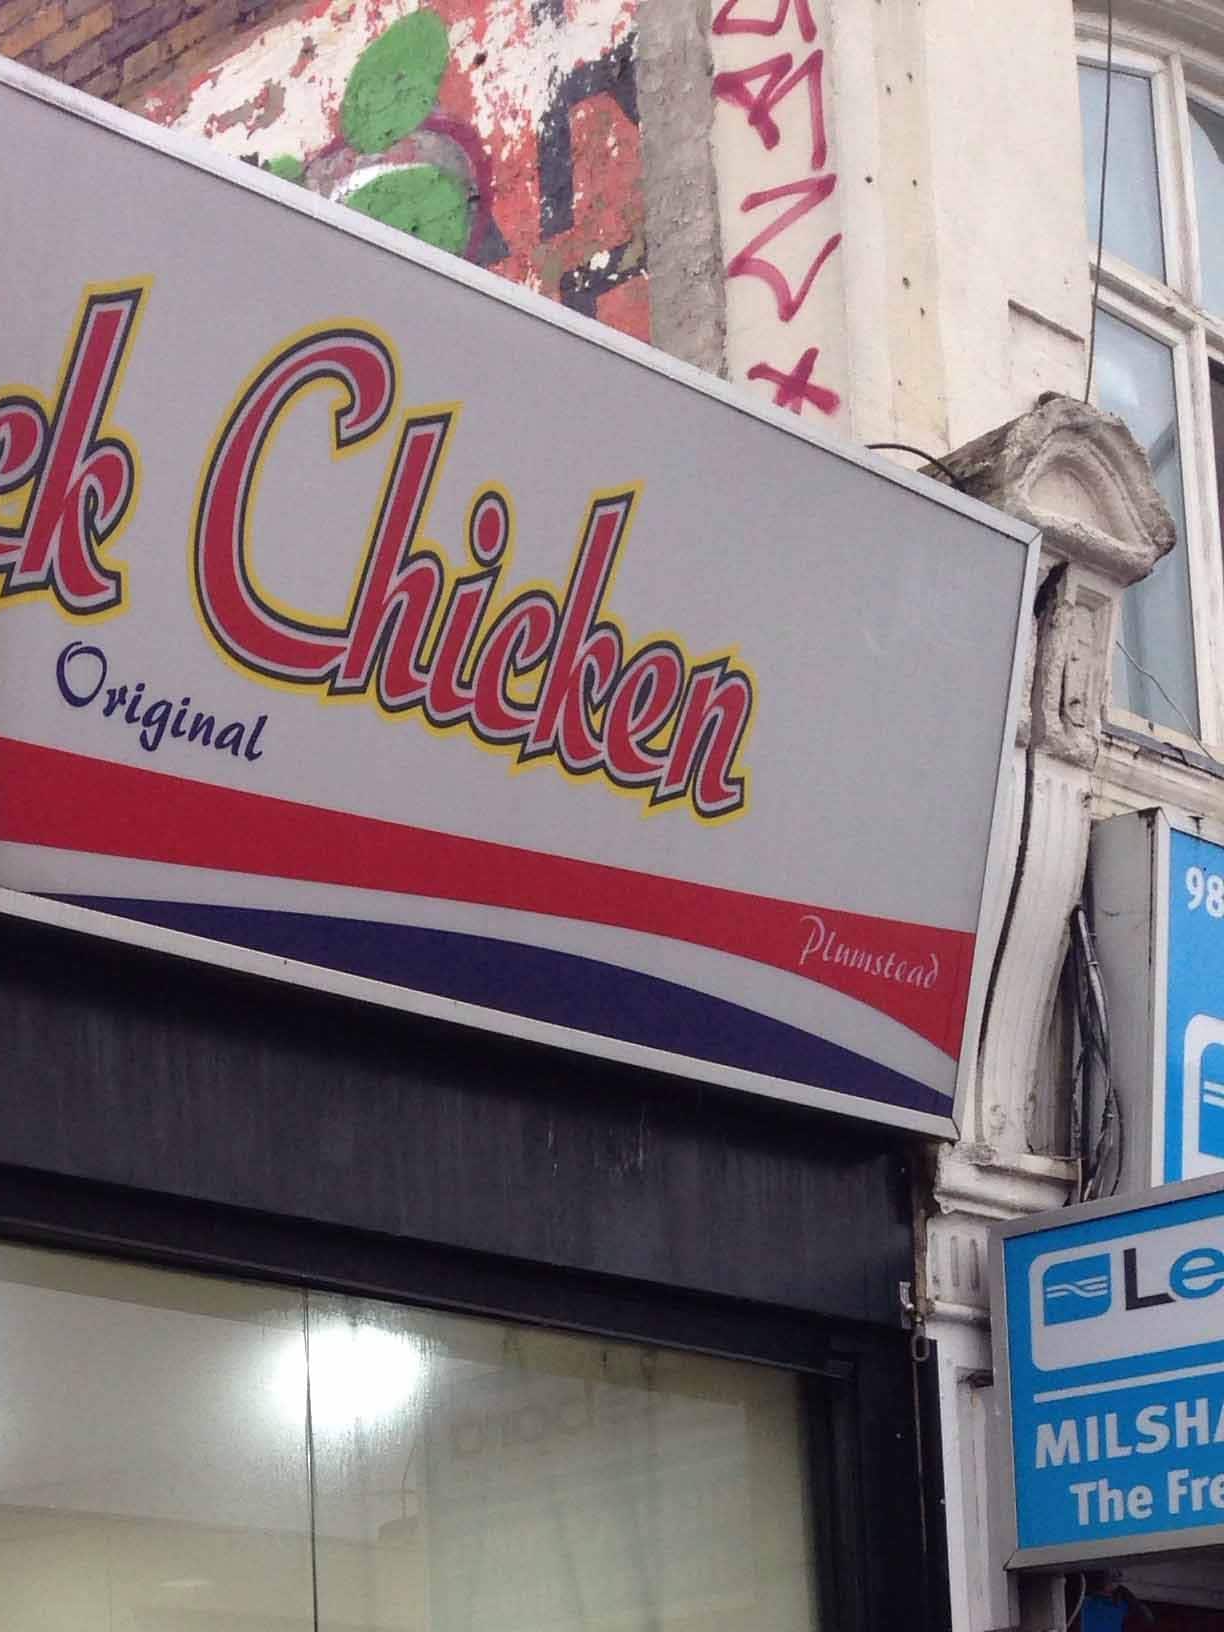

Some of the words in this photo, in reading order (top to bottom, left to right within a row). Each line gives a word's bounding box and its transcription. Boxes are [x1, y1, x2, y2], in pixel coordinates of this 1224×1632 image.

[189, 321, 761, 824] Chicken
[56, 641, 268, 761] Original
[1185, 866, 1224, 918] 98
[800, 915, 939, 989] Plumstead
[1035, 1398, 1224, 1469] MILSH
[1069, 1478, 1153, 1526] The
